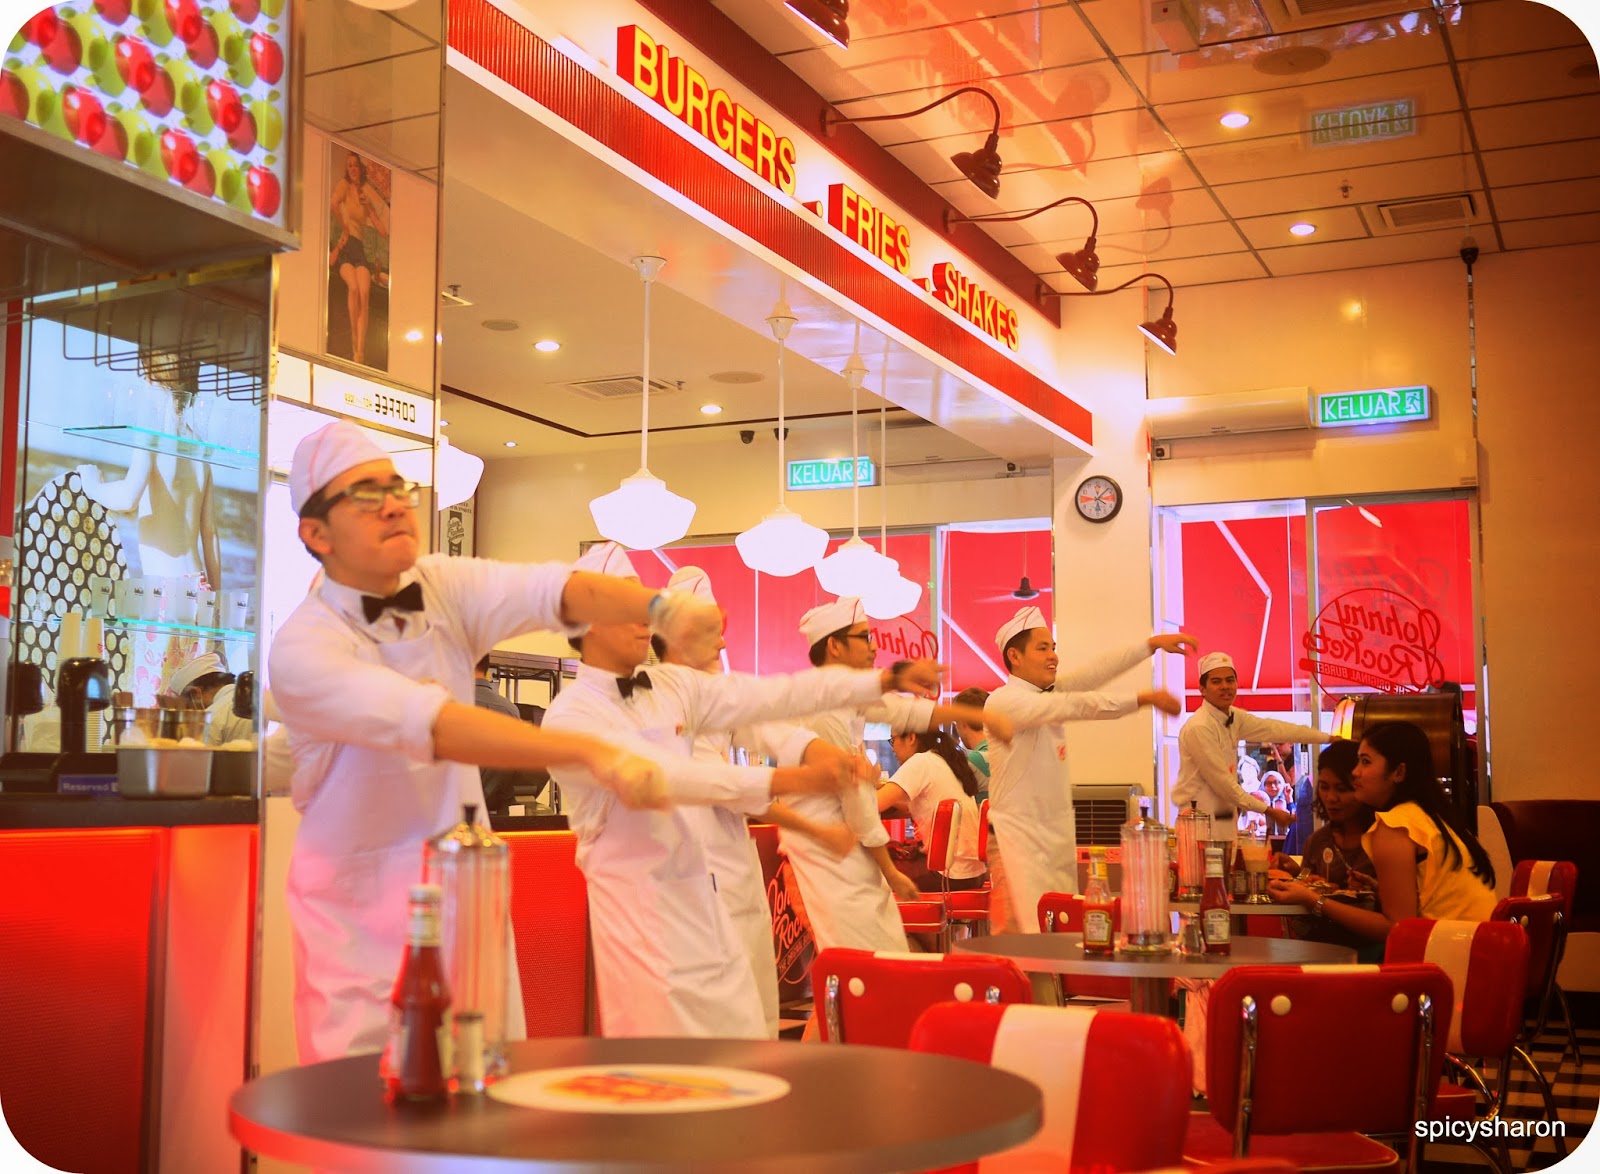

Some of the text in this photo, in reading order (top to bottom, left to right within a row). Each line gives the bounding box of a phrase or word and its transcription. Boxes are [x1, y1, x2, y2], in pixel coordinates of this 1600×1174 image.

[631, 25, 1019, 353] BURGERS FRIES SHAKES
[1323, 392, 1402, 420] KELUAR
[792, 462, 854, 485] KELUAR
